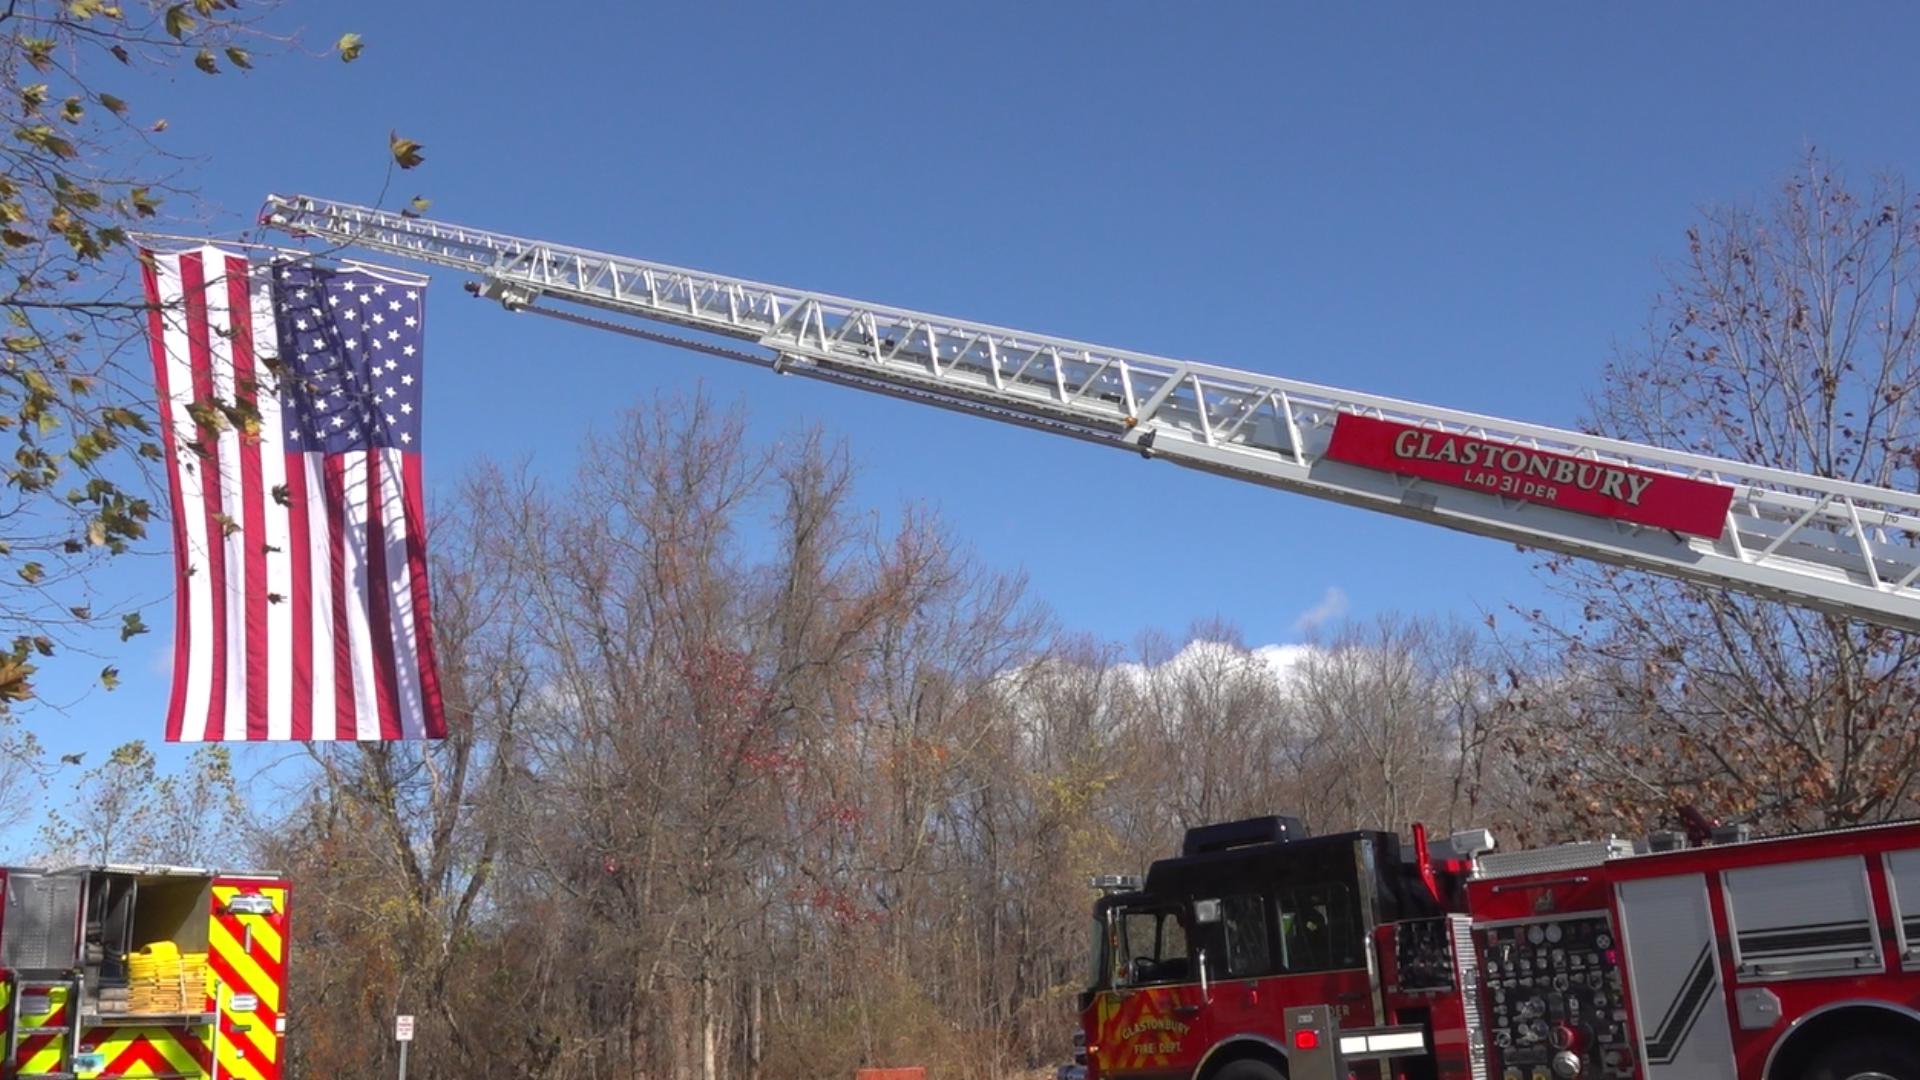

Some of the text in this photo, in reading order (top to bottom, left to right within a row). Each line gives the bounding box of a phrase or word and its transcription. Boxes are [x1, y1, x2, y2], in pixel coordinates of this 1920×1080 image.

[1394, 429, 1654, 506] GLASTONBURY
[1464, 469, 1558, 500] LAD 31 DER
[1122, 1018, 1190, 1040] GLASTONBURY
[1135, 1042, 1154, 1054] FIRE
